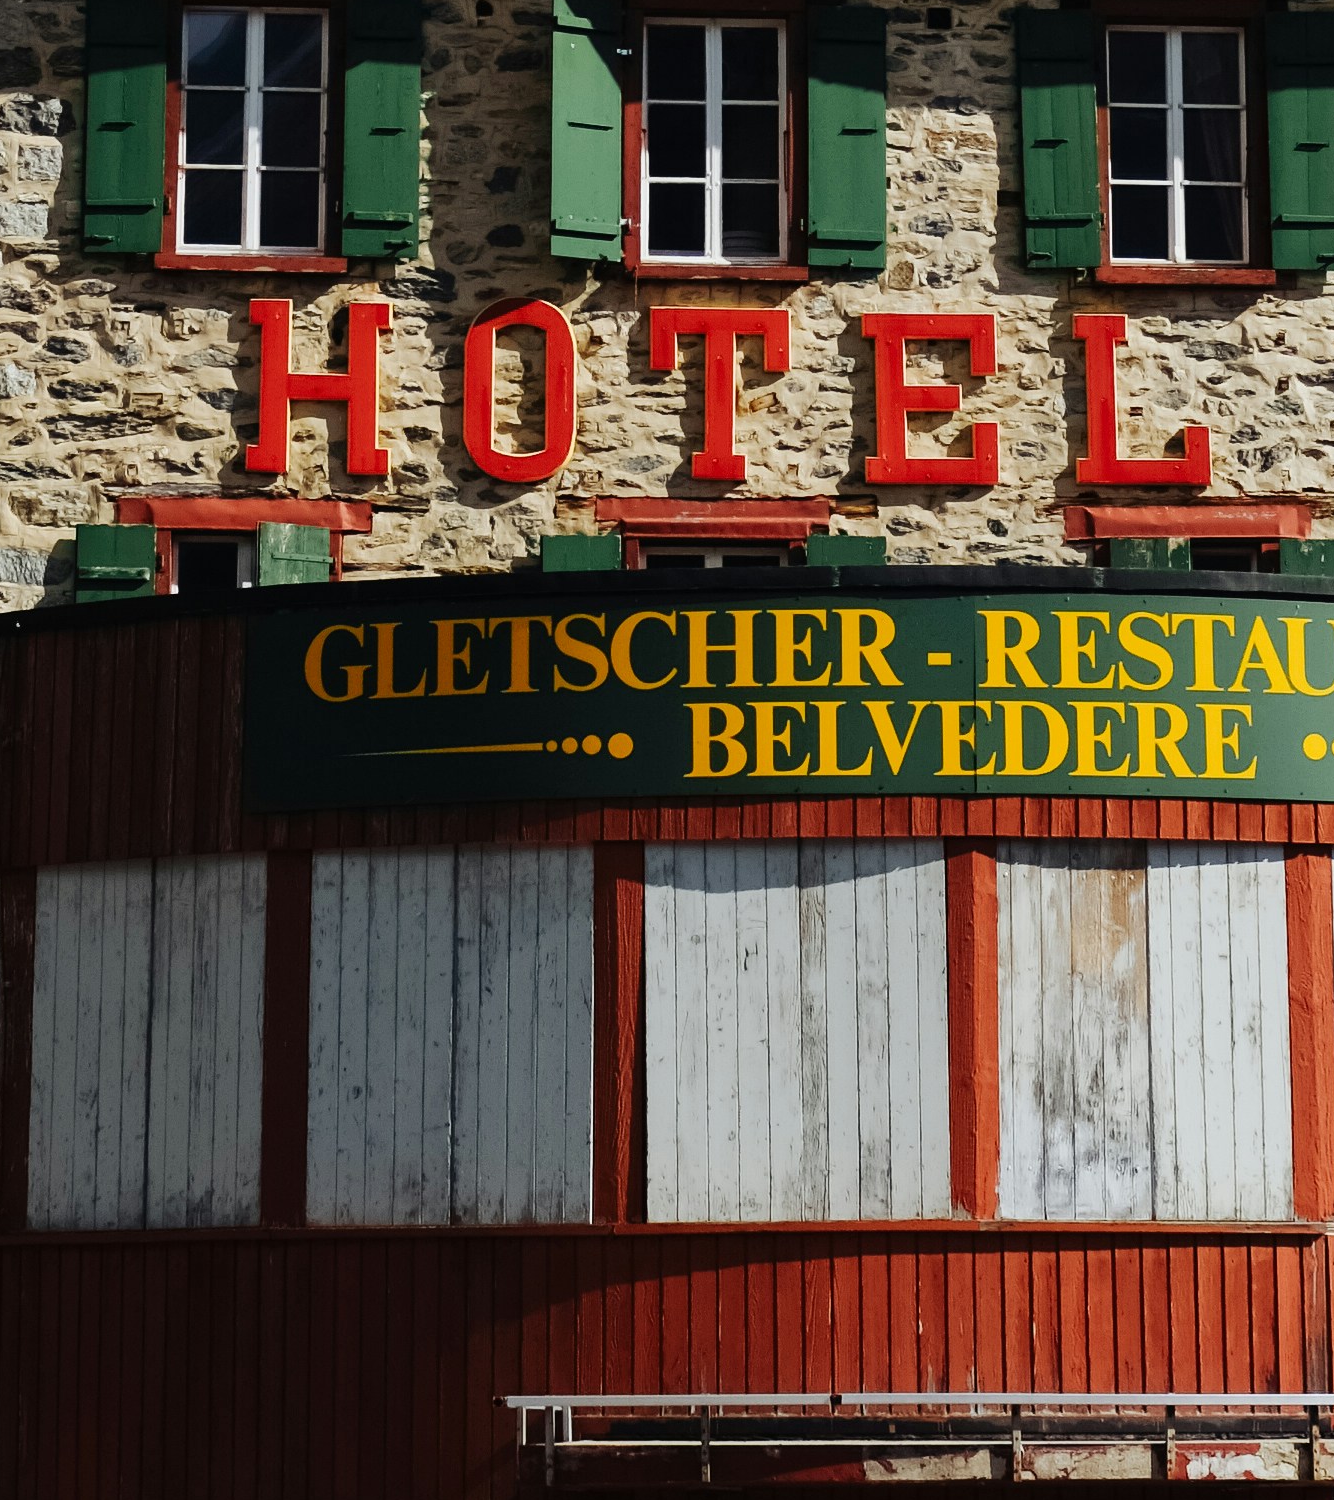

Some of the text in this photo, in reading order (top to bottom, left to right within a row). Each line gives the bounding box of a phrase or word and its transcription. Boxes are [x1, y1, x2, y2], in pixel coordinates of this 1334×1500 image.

[246, 298, 1212, 486] HOTEL
[304, 608, 904, 702] GLETSCHER
[683, 700, 1258, 780] BELVEDERE
